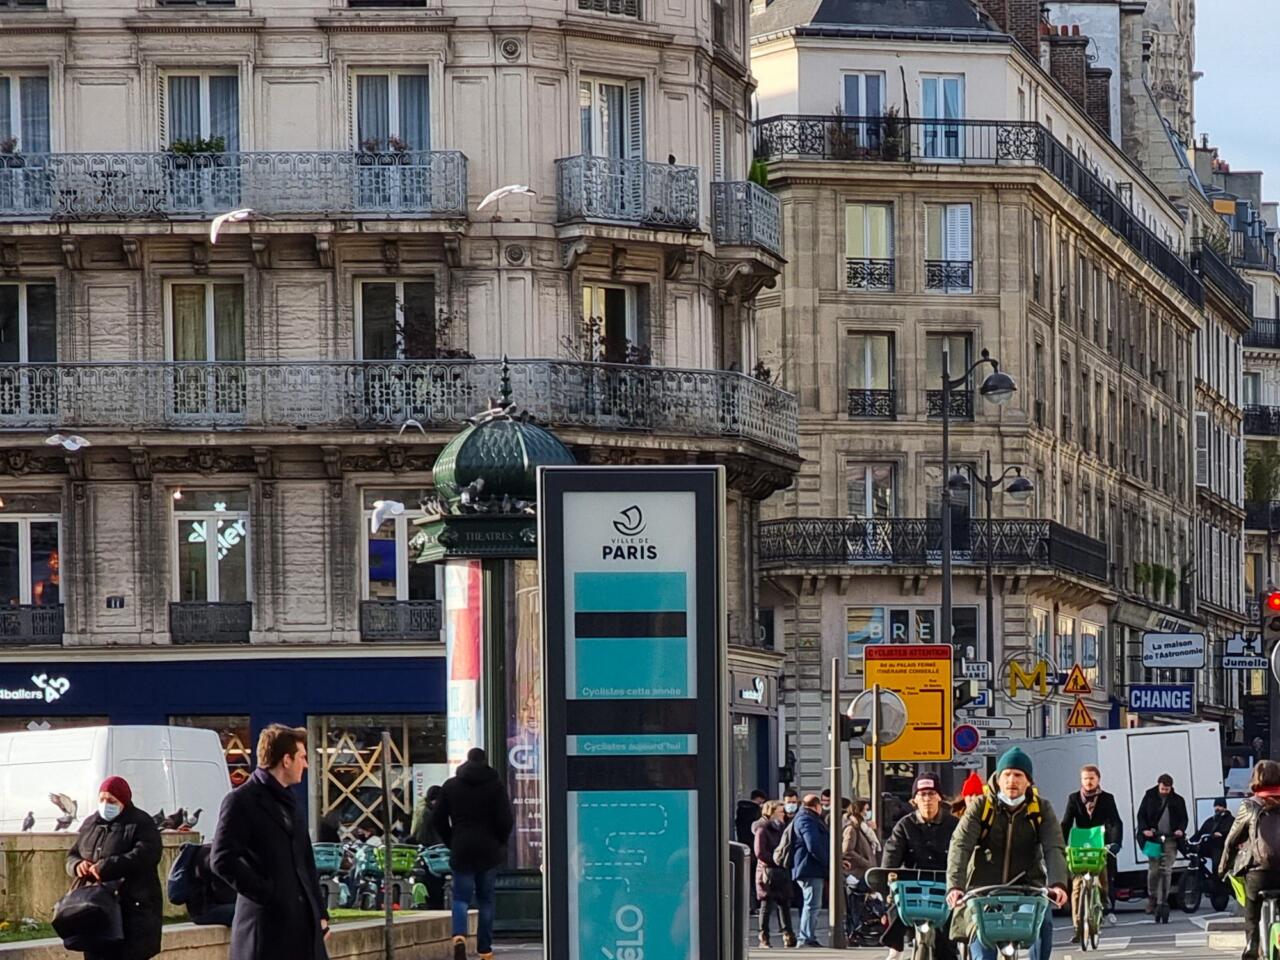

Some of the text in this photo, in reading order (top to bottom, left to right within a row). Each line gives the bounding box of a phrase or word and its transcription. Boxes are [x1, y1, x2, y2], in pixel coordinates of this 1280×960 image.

[602, 545, 657, 559] PARIS
[870, 622, 955, 639] BRE
[1164, 639, 1192, 649] maison
[1144, 648, 1203, 661] de l'Astronomie
[1224, 658, 1268, 667] Jumelle
[1010, 659, 1047, 698] M
[582, 687, 625, 697] Cyclistes
[1131, 690, 1191, 709] CHANGE
[584, 742, 626, 751] Cyclistes
